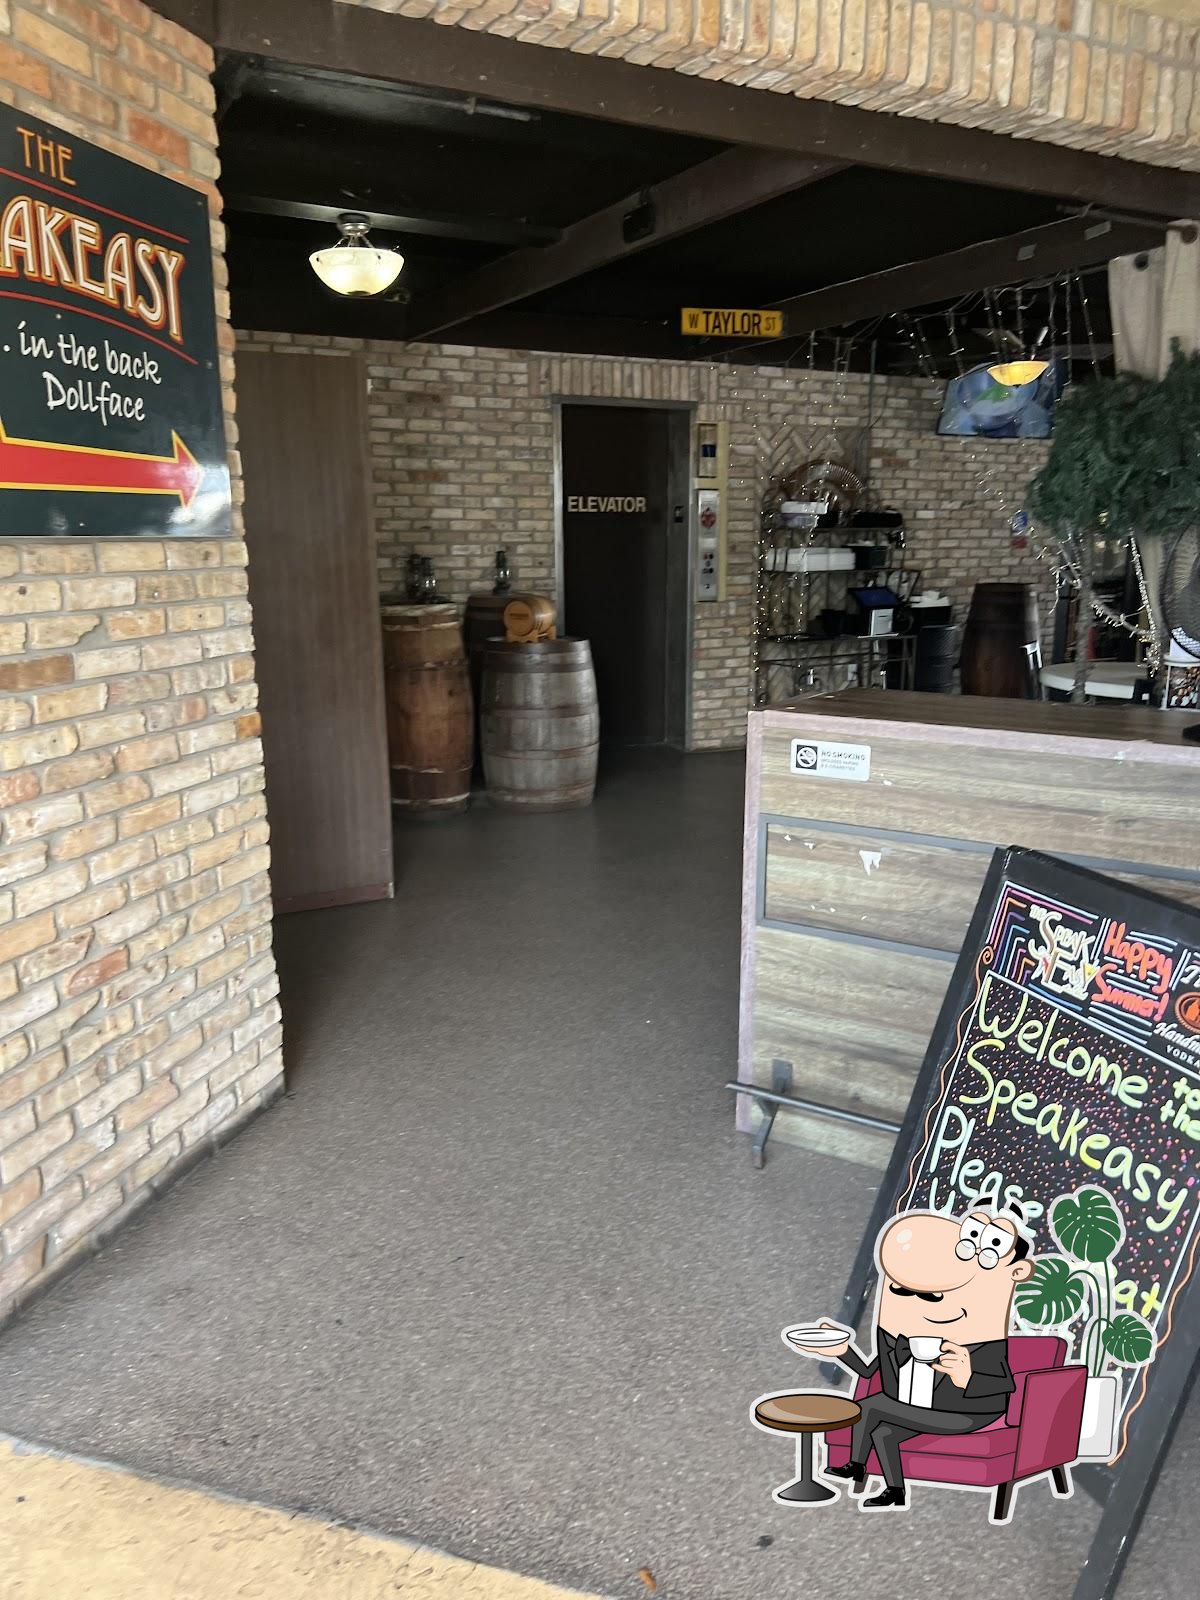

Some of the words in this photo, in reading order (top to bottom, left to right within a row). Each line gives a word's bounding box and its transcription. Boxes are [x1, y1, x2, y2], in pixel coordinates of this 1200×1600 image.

[17, 127, 76, 185] THE
[688, 313, 699, 328] W
[702, 311, 761, 335] TAYLOR
[764, 316, 777, 332] ST
[17, 320, 54, 358] in
[57, 333, 99, 371] the
[104, 340, 162, 385] back
[42, 371, 145, 426] Dollface
[567, 496, 647, 513] ELEVATOR
[1103, 921, 1173, 994] Happy
[1092, 963, 1169, 1022] Summer!
[978, 976, 1148, 1108] Welcome
[1160, 1099, 1200, 1141] the
[1172, 1077, 1200, 1111] to
[958, 1038, 1188, 1232] Speakeasy
